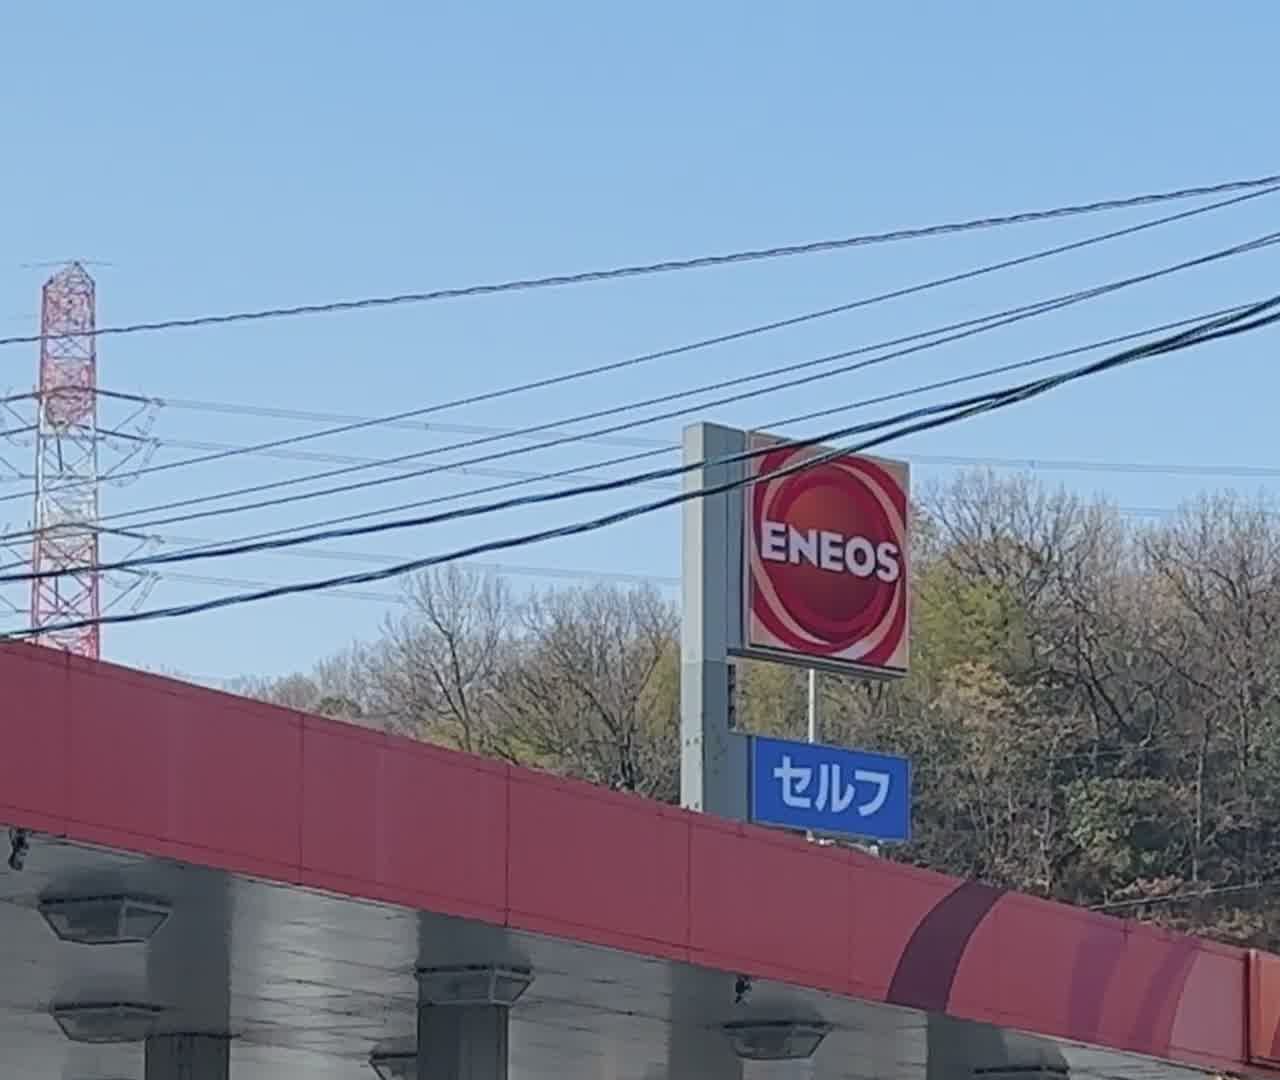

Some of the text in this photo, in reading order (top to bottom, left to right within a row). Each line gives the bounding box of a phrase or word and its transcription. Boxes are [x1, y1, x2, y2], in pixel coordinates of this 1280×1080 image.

[760, 521, 900, 583] ENEOS
[773, 755, 890, 817] セルフ
